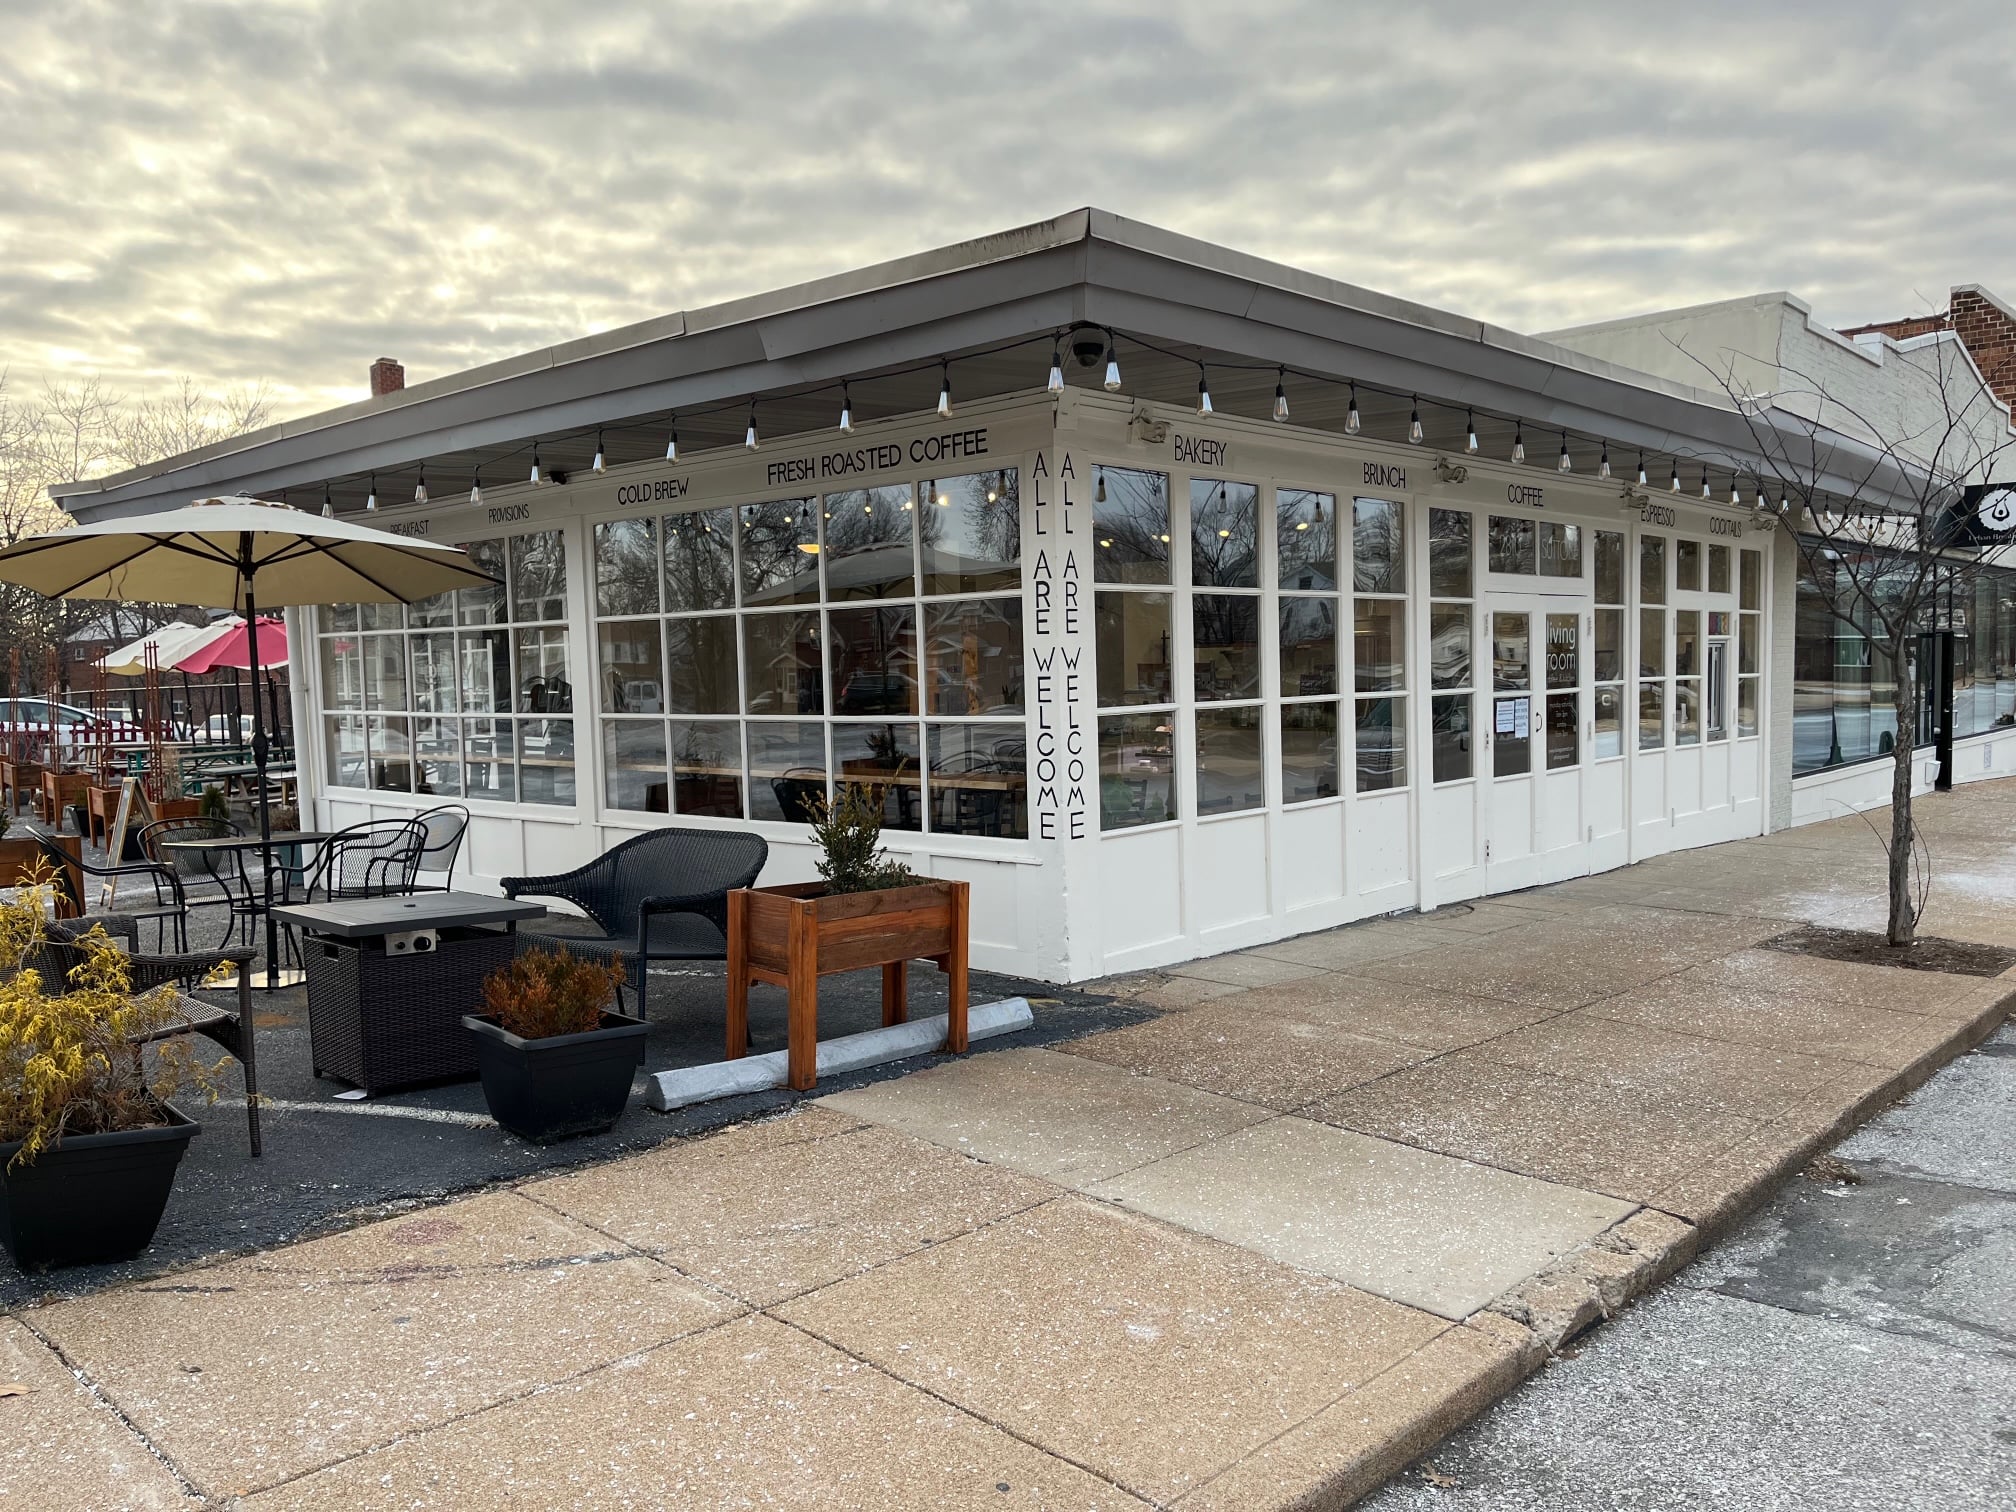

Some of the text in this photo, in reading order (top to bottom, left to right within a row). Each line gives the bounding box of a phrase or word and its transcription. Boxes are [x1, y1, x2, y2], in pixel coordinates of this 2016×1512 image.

[767, 428, 988, 485] FRESH ROASTED COFFEE
[1174, 434, 1227, 466] BAKERY
[1363, 462, 1406, 489] BRUNCH
[617, 477, 690, 505] COLD BREW
[1507, 484, 1545, 507] COFFEE
[488, 503, 530, 524] PROVISIONS
[1641, 505, 1676, 528] ESPRESSO
[1709, 516, 1742, 538] COCKTAILS
[390, 519, 430, 537] BREAKFAST
[1033, 451, 1058, 840] ALL ARE WELCOME
[1061, 451, 1085, 840] ALL ARE WELCOME
[1546, 619, 1576, 650] living
[1546, 653, 1576, 671] room
